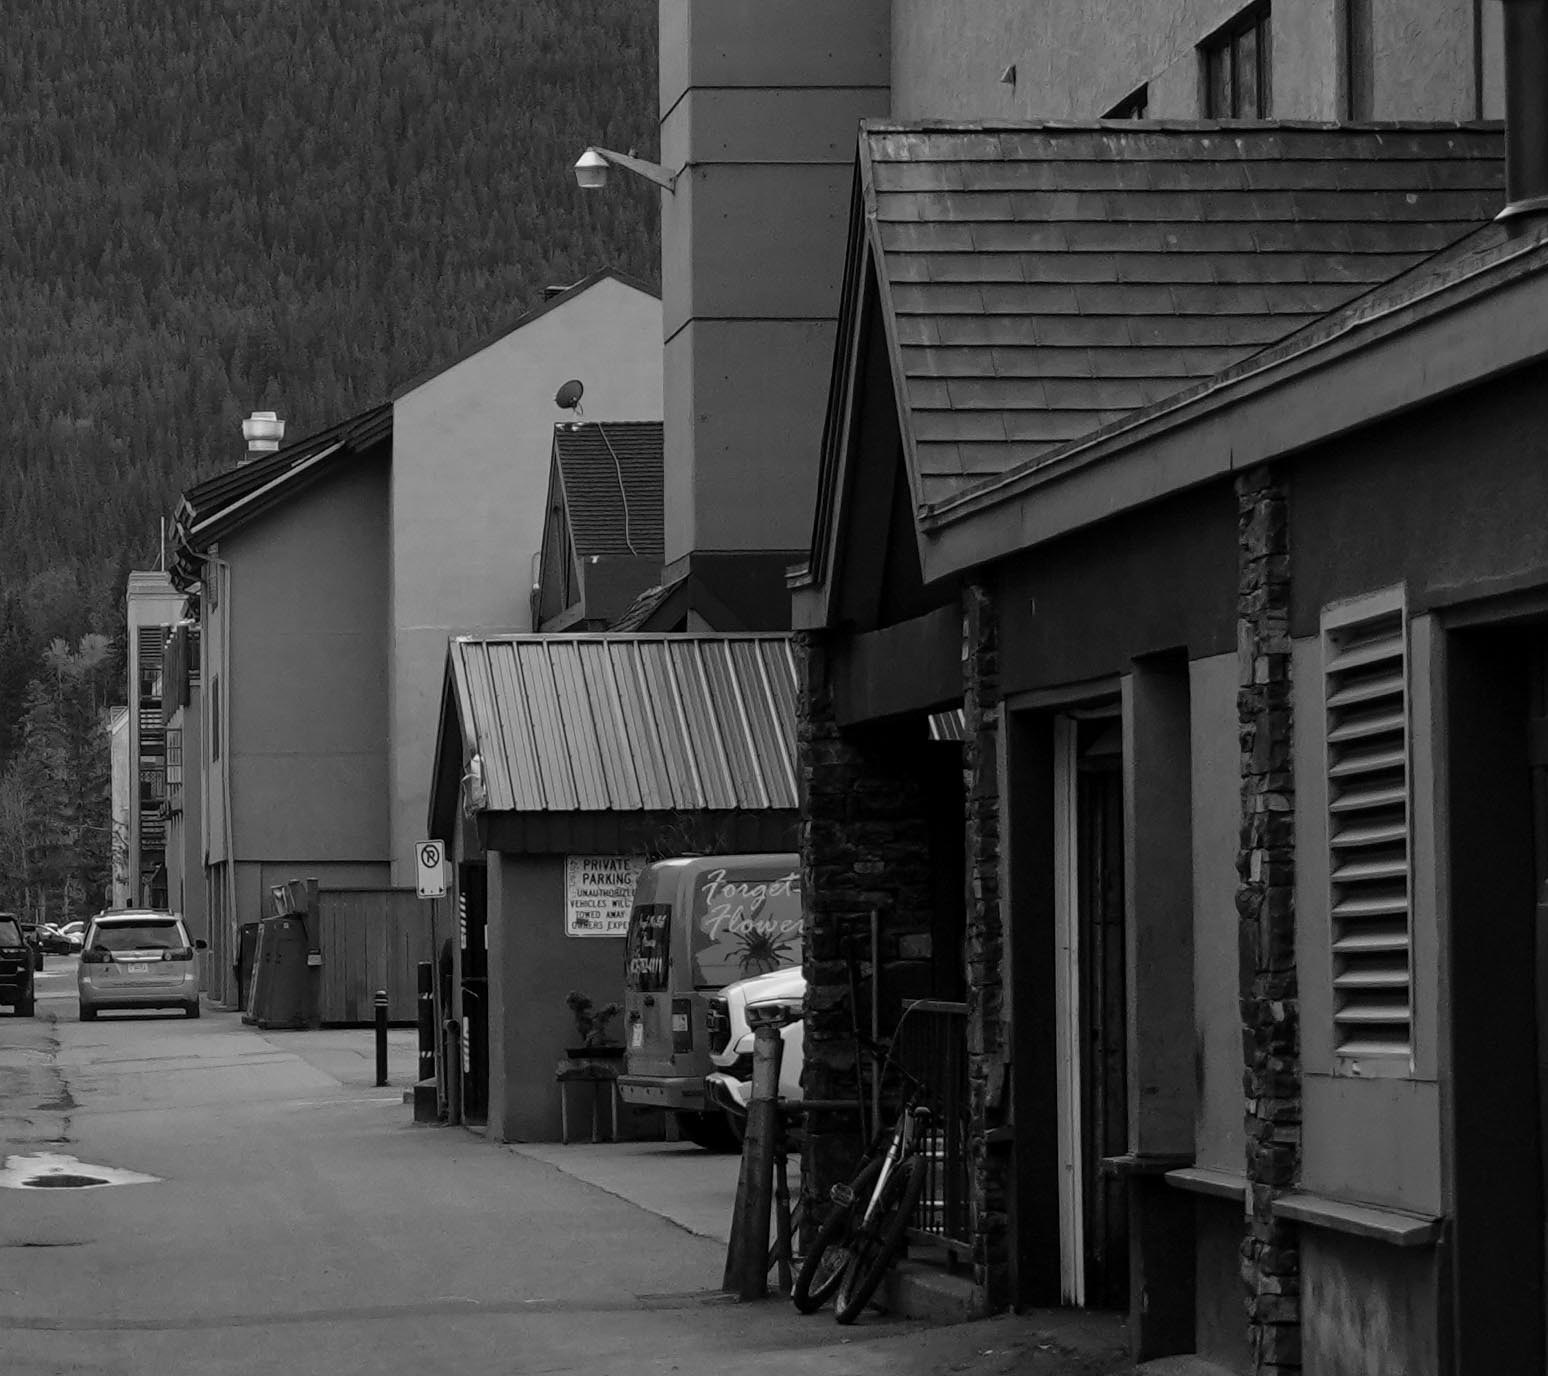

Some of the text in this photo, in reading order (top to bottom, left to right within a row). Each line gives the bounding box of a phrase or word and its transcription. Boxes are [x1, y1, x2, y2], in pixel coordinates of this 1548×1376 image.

[583, 858, 631, 870] PRIVATE
[582, 873, 631, 885] PARKING
[571, 900, 607, 908] VEHICLES
[576, 910, 625, 919] TOWED AWAY
[571, 920, 603, 930] OWNERS
